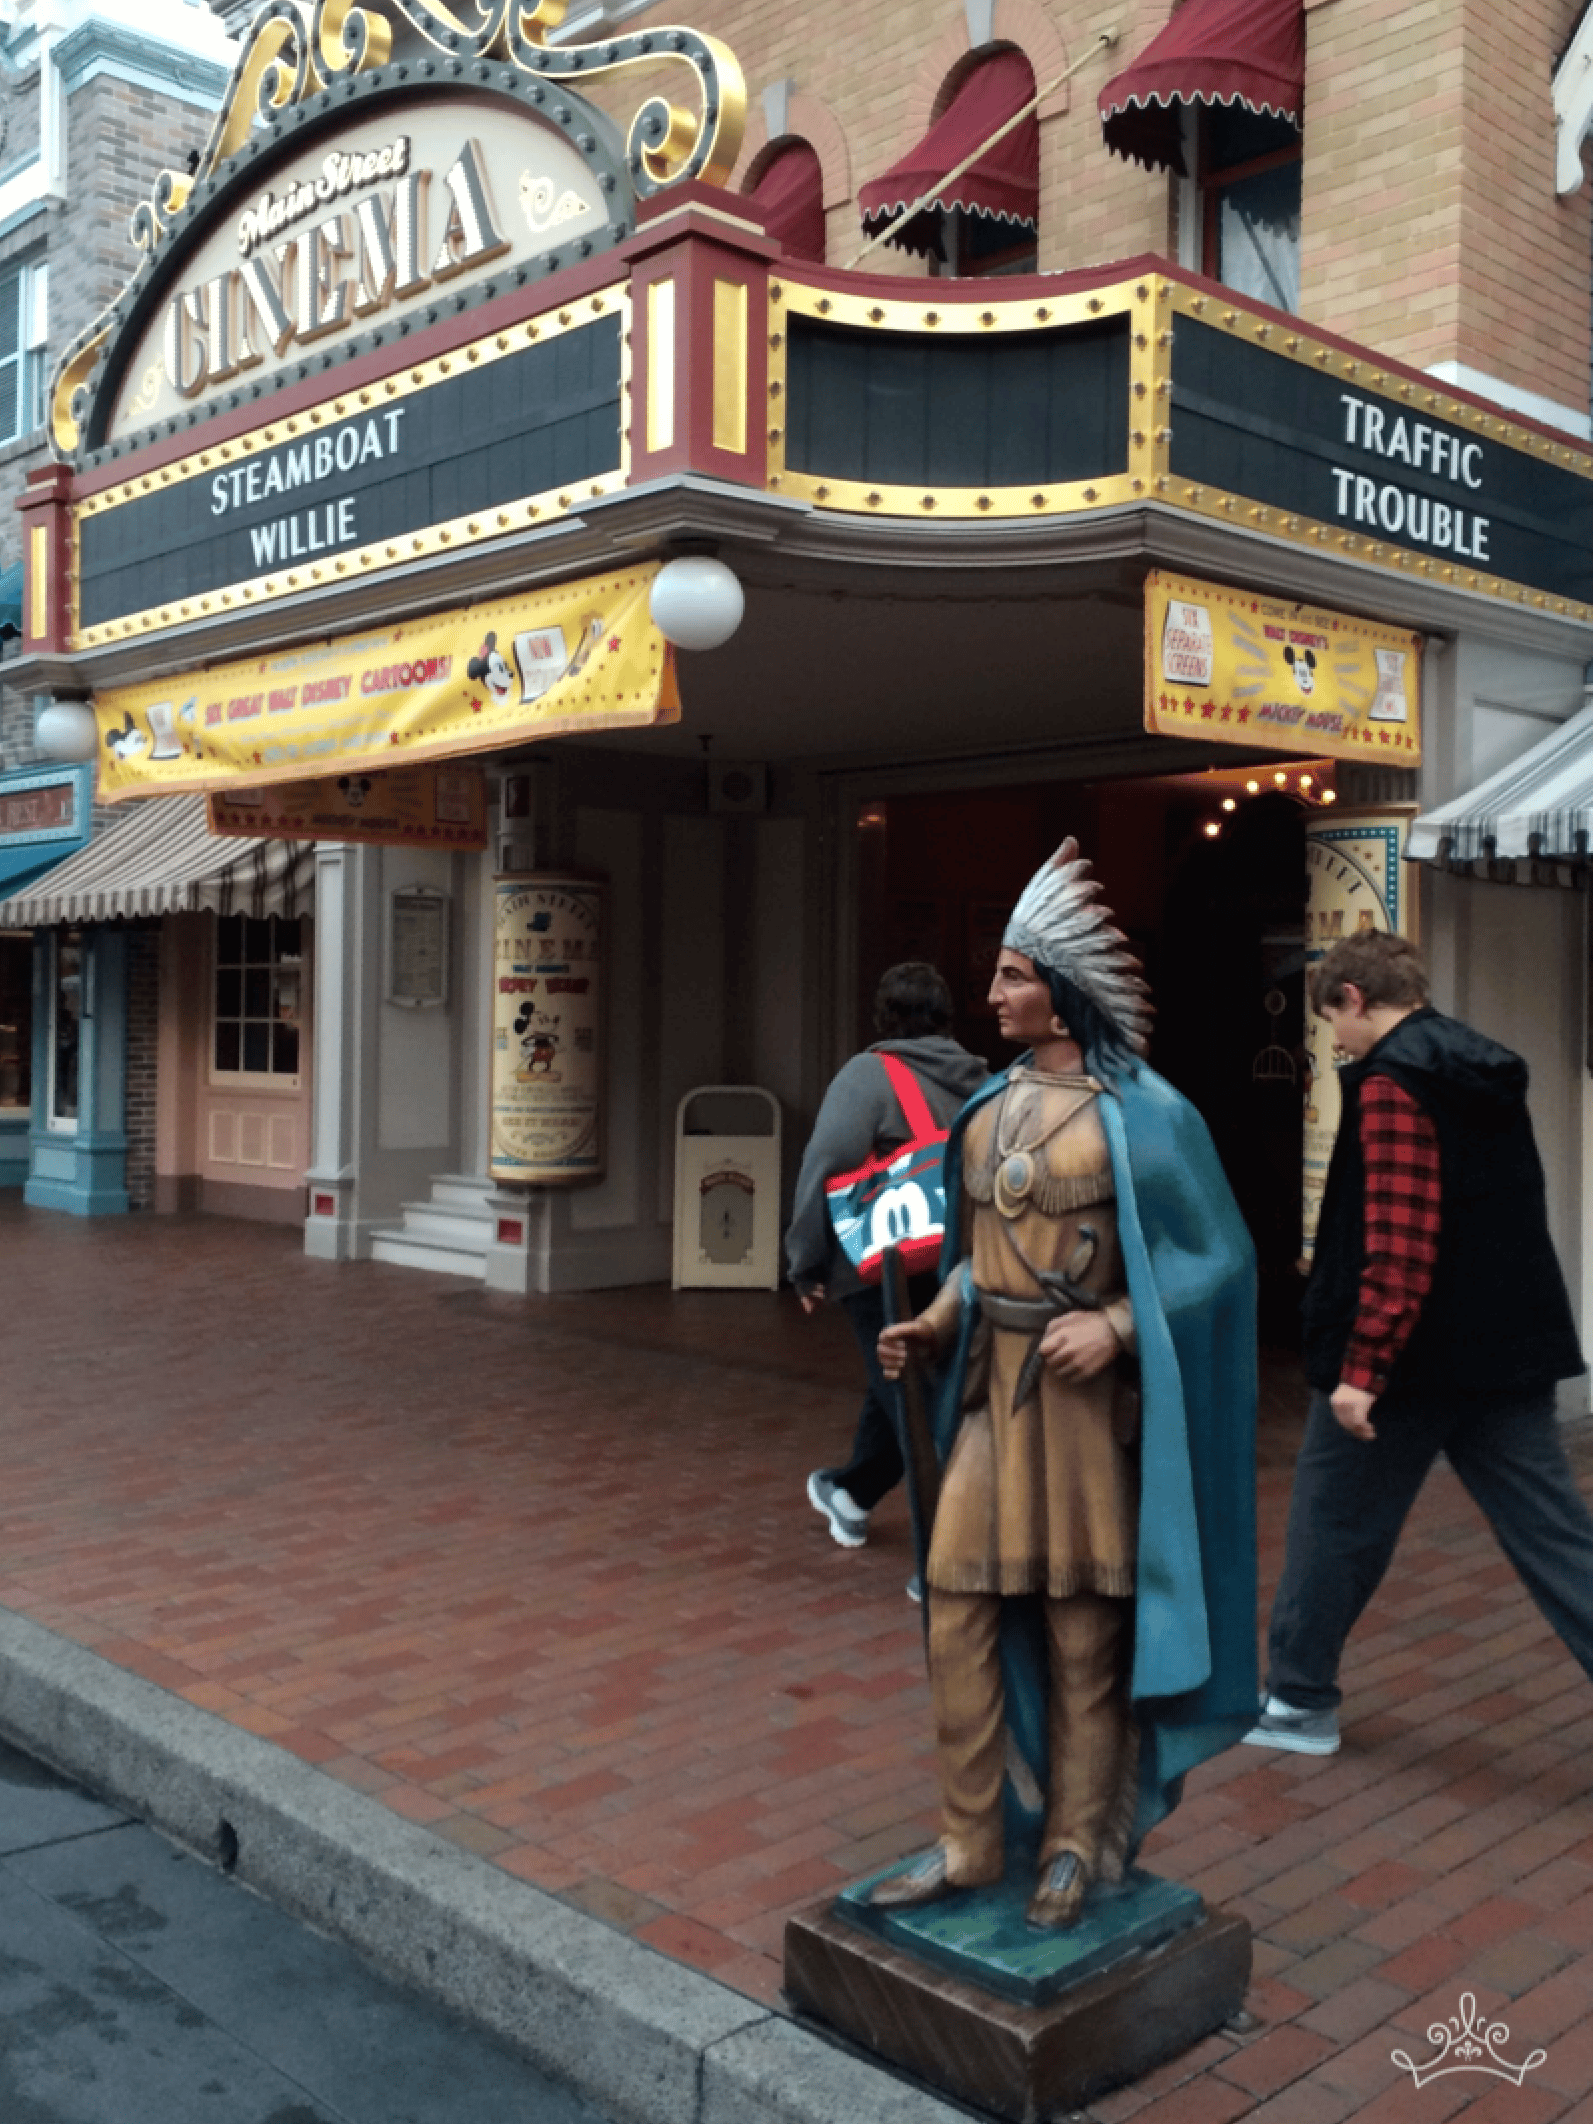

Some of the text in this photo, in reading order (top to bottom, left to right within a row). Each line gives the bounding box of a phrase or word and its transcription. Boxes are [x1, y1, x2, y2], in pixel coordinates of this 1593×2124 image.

[238, 135, 411, 258] Main Street
[163, 138, 511, 398] CINEMA
[210, 409, 404, 516] STEAMBOAT
[1341, 395, 1484, 489] TRAFFIC
[250, 498, 358, 568] WILLIE
[1332, 468, 1490, 562] TROUBLE
[227, 692, 264, 720] GREAT
[301, 674, 352, 707] DISNEY
